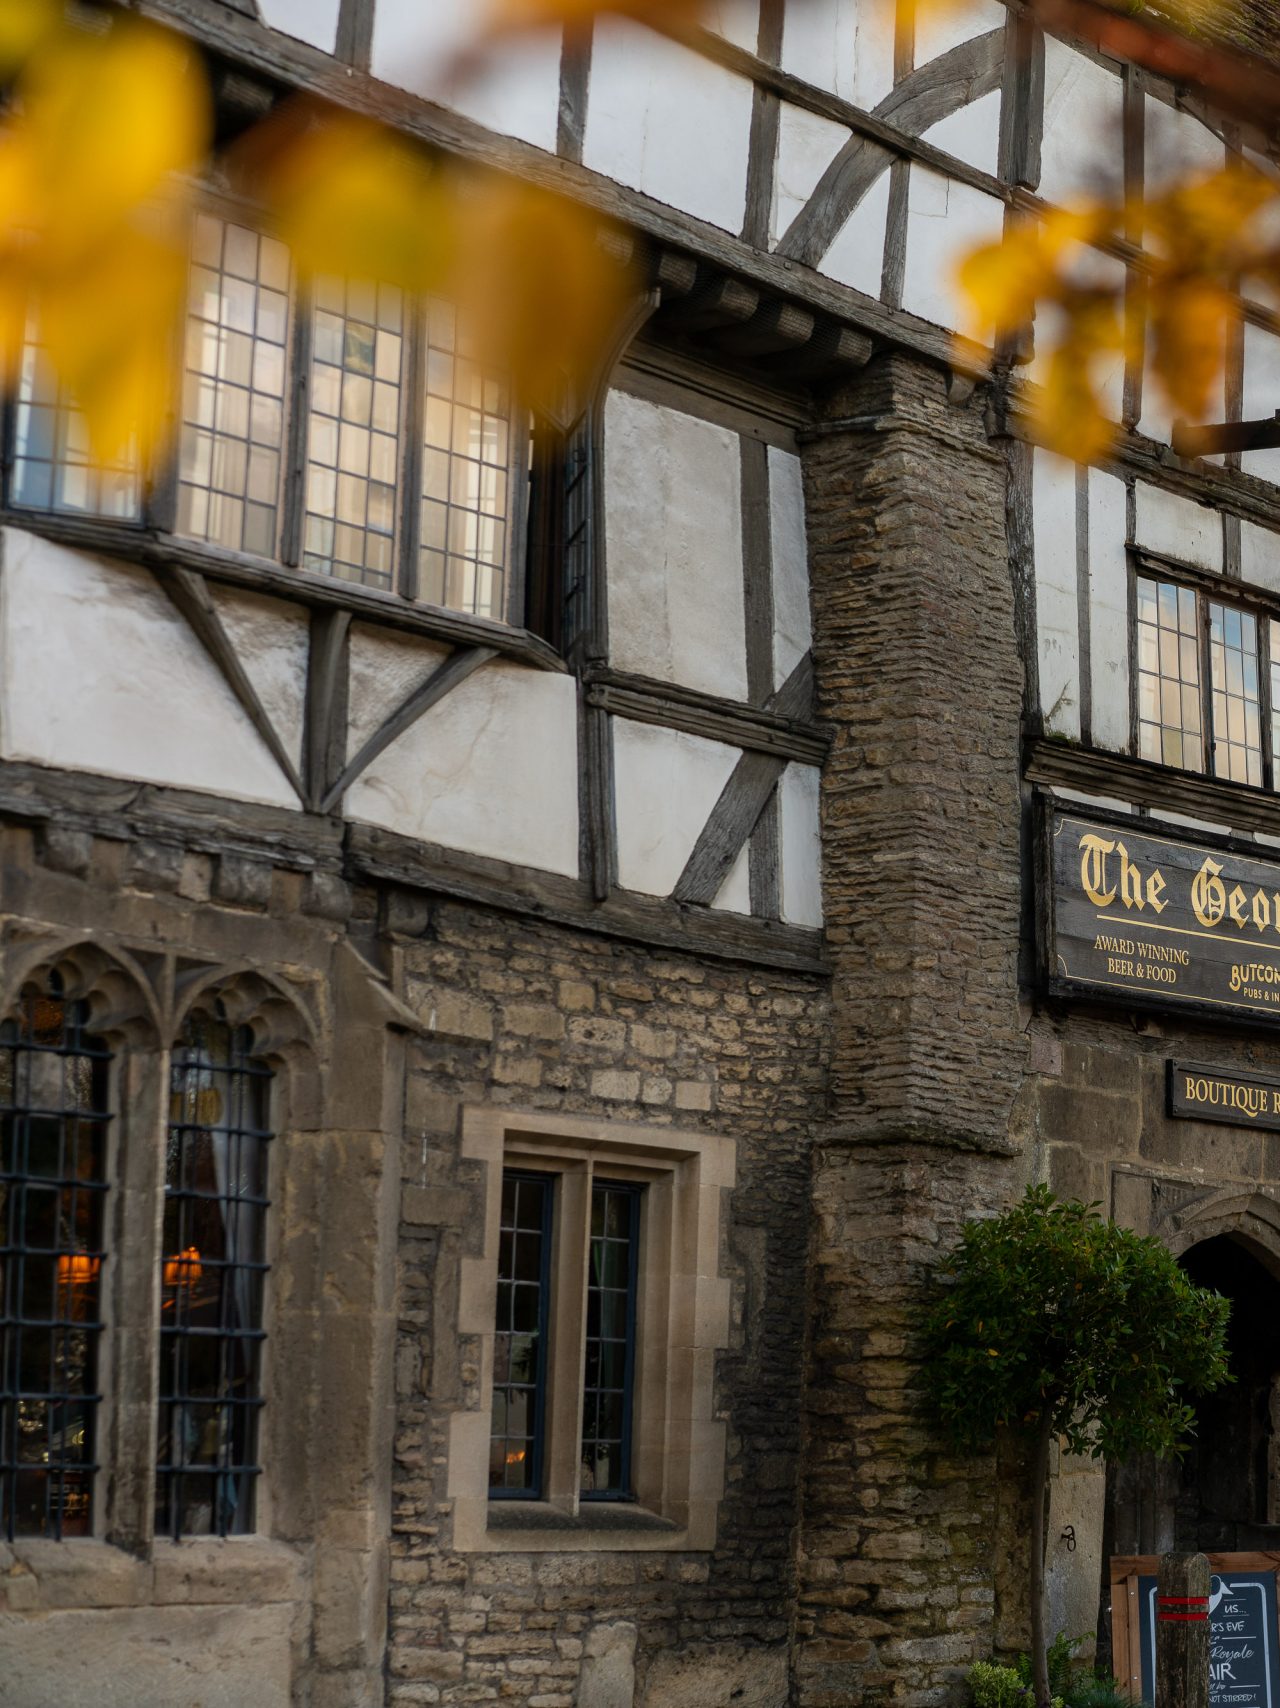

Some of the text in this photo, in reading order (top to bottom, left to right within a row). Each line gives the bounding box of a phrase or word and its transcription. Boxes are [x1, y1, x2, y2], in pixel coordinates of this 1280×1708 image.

[1079, 833, 1169, 914] The
[1094, 935, 1190, 965] AWARD WINNING
[1108, 957, 1177, 984] BEER & FOOD
[1243, 987, 1263, 999] PUBS
[1264, 990, 1270, 1001] &
[1185, 1077, 1268, 1117] BOUTIQUE
